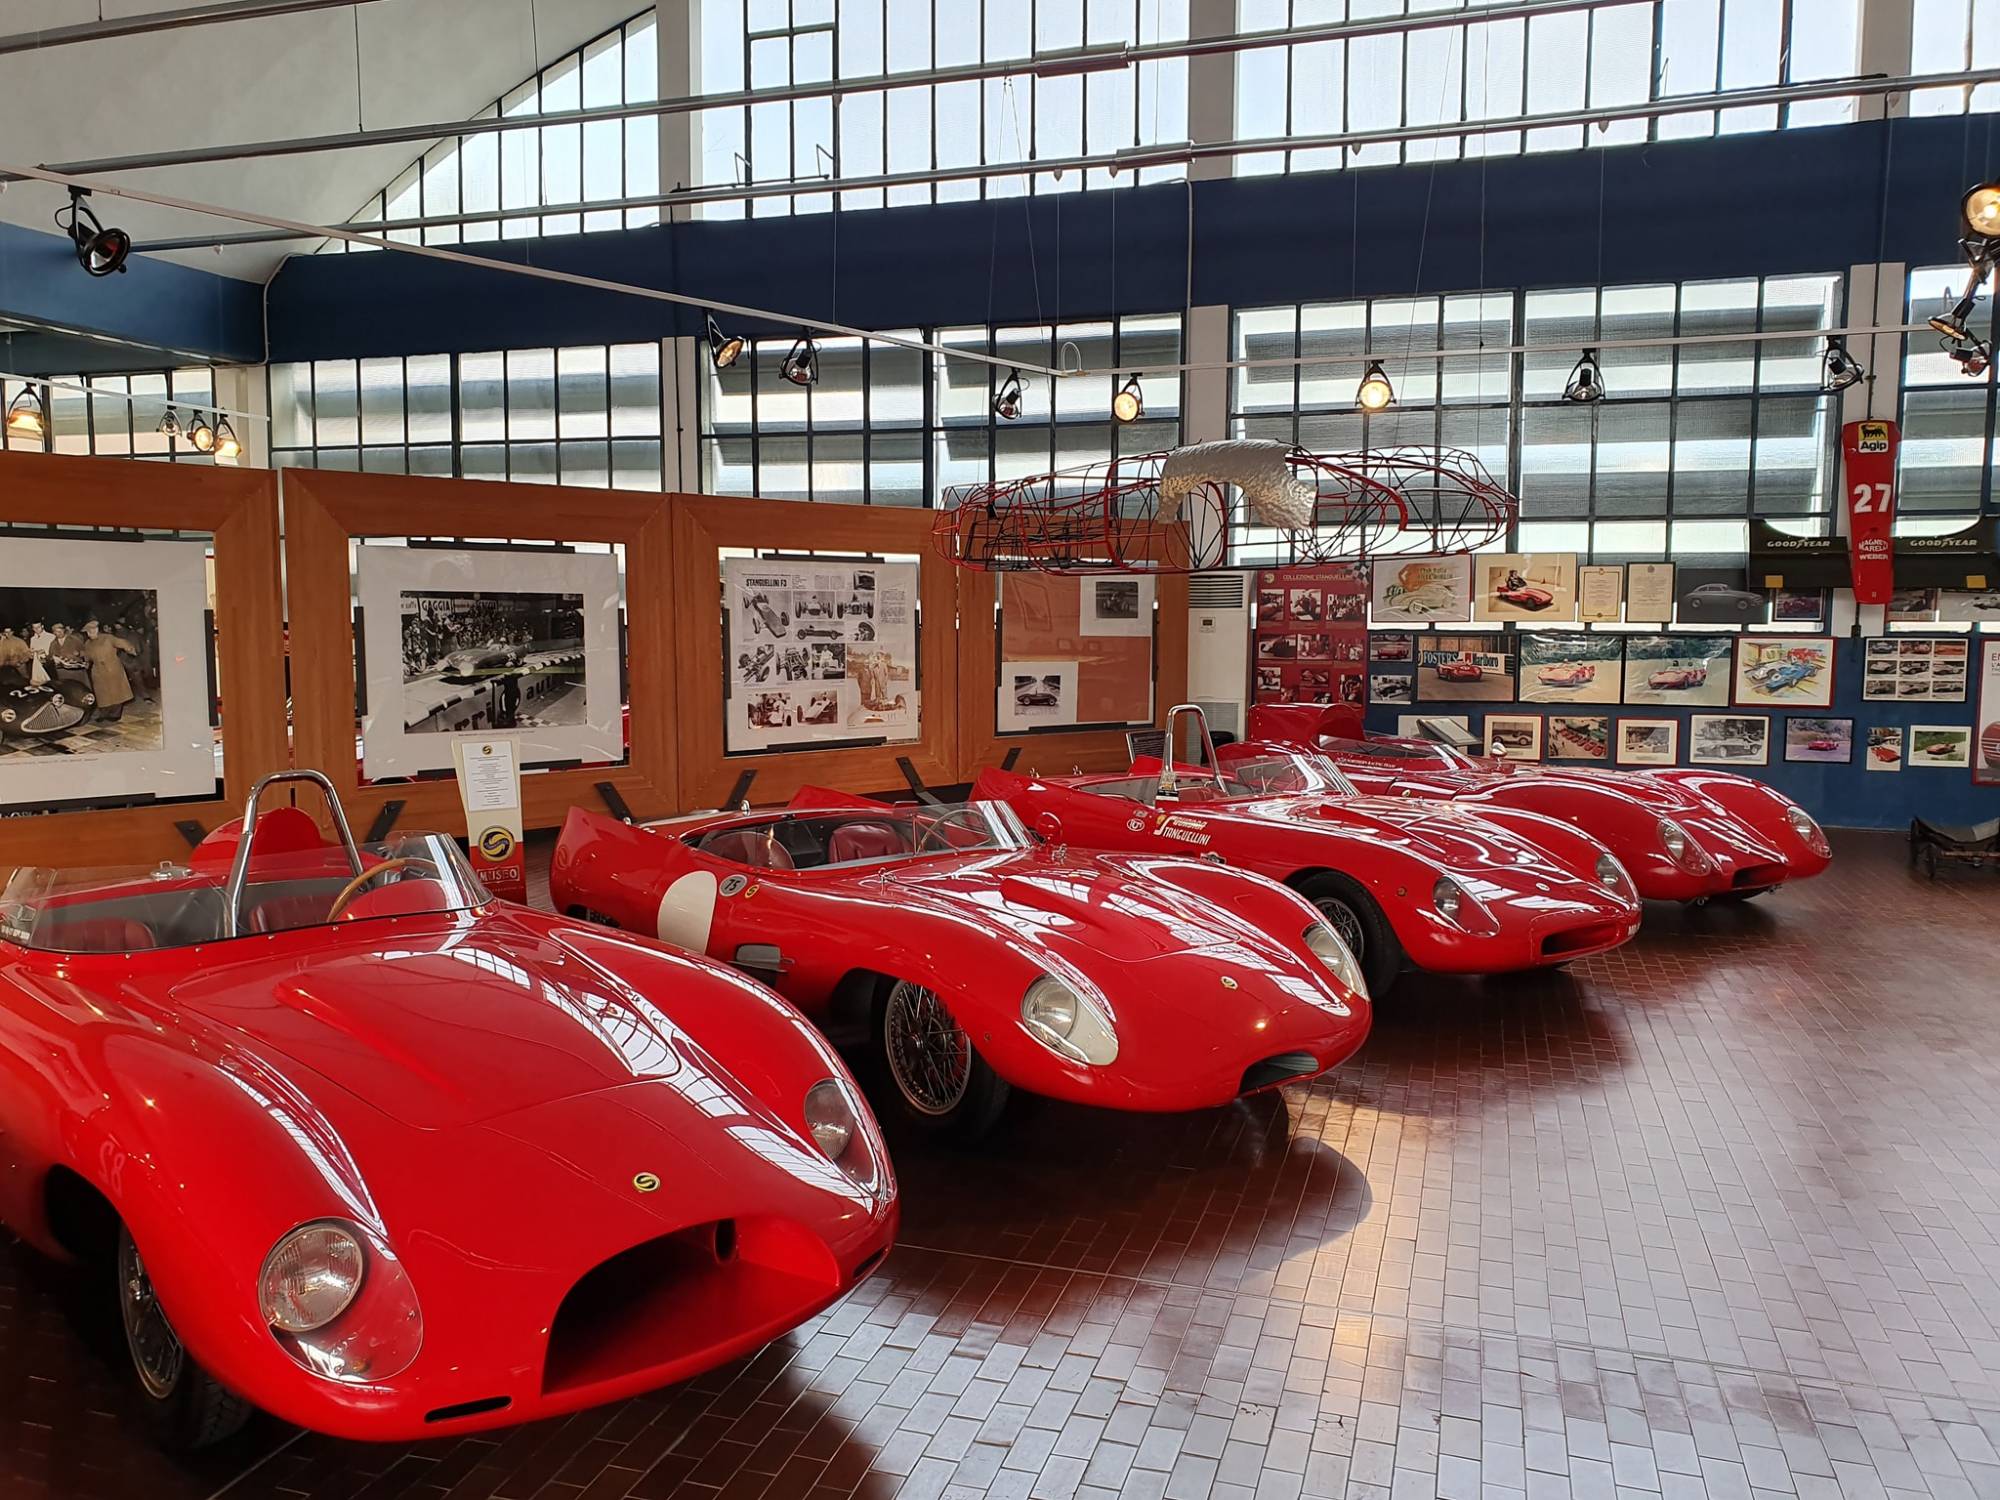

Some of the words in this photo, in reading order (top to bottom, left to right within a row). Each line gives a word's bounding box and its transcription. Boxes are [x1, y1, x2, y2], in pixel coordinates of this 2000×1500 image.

[1860, 441, 1887, 451] Agip
[1854, 484, 1891, 514] 27
[1767, 539, 1830, 549] GOODYEAR
[1910, 538, 1977, 548] GOODYEAR
[422, 600, 450, 611] GAGGIA
[1153, 816, 1211, 846] STANGUELLINI
[480, 869, 517, 881] MUSEO
